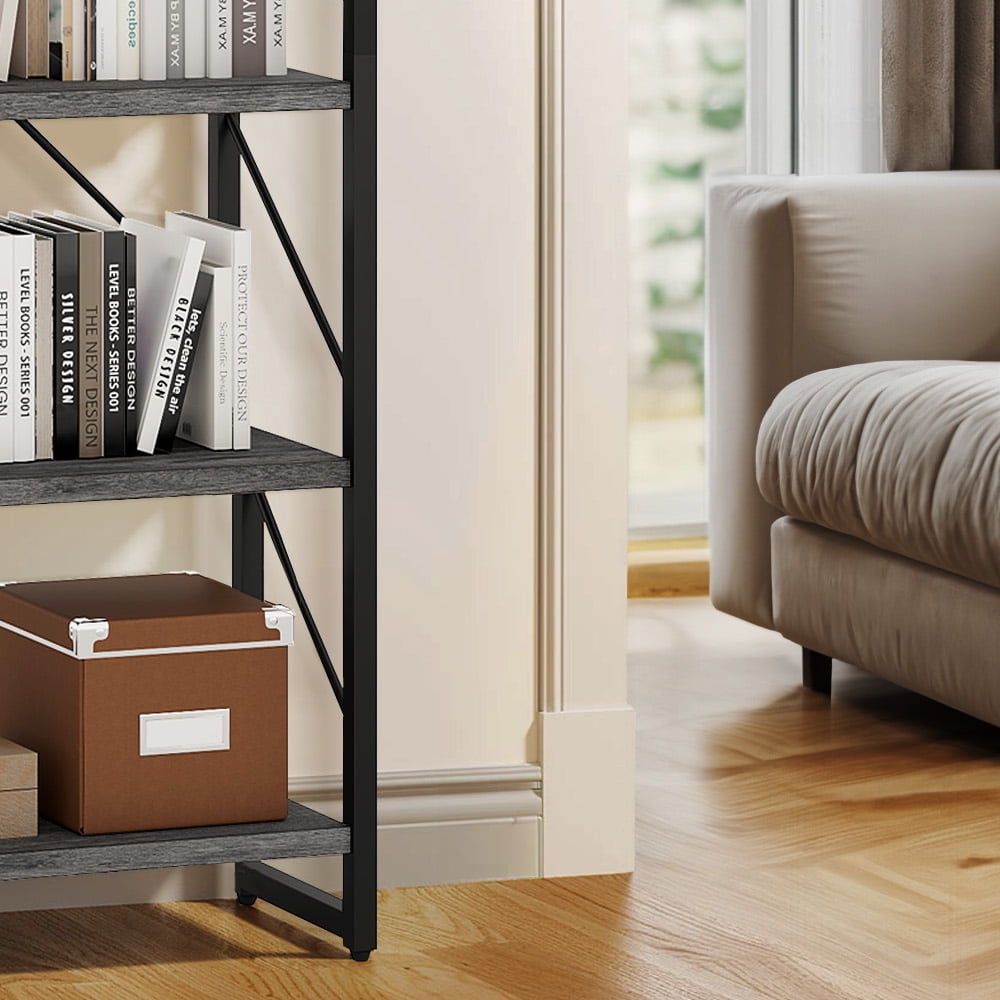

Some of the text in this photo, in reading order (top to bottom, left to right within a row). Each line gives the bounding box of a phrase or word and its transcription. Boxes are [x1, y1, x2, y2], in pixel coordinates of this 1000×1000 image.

[20, 268, 30, 303] LEVEL
[109, 264, 119, 299] LEVEL
[20, 306, 30, 345] BOOKS
[109, 302, 119, 342] BOOKS
[61, 293, 74, 404] SILVER DESIGN
[127, 287, 136, 410] BETTER DESIGN
[155, 297, 189, 399] BLACK DESIGN
[178, 337, 193, 371] clean
[218, 321, 228, 404] Scientific Design
[238, 265, 248, 421] PROTECT OUR DESIGN
[20, 355, 30, 394] SERIES
[85, 305, 98, 448] THE NEXT DESIGN
[109, 350, 119, 390] SERIES
[172, 373, 186, 395] the
[20, 397, 30, 417] 001
[109, 391, 119, 412] 001
[168, 397, 179, 415] air
